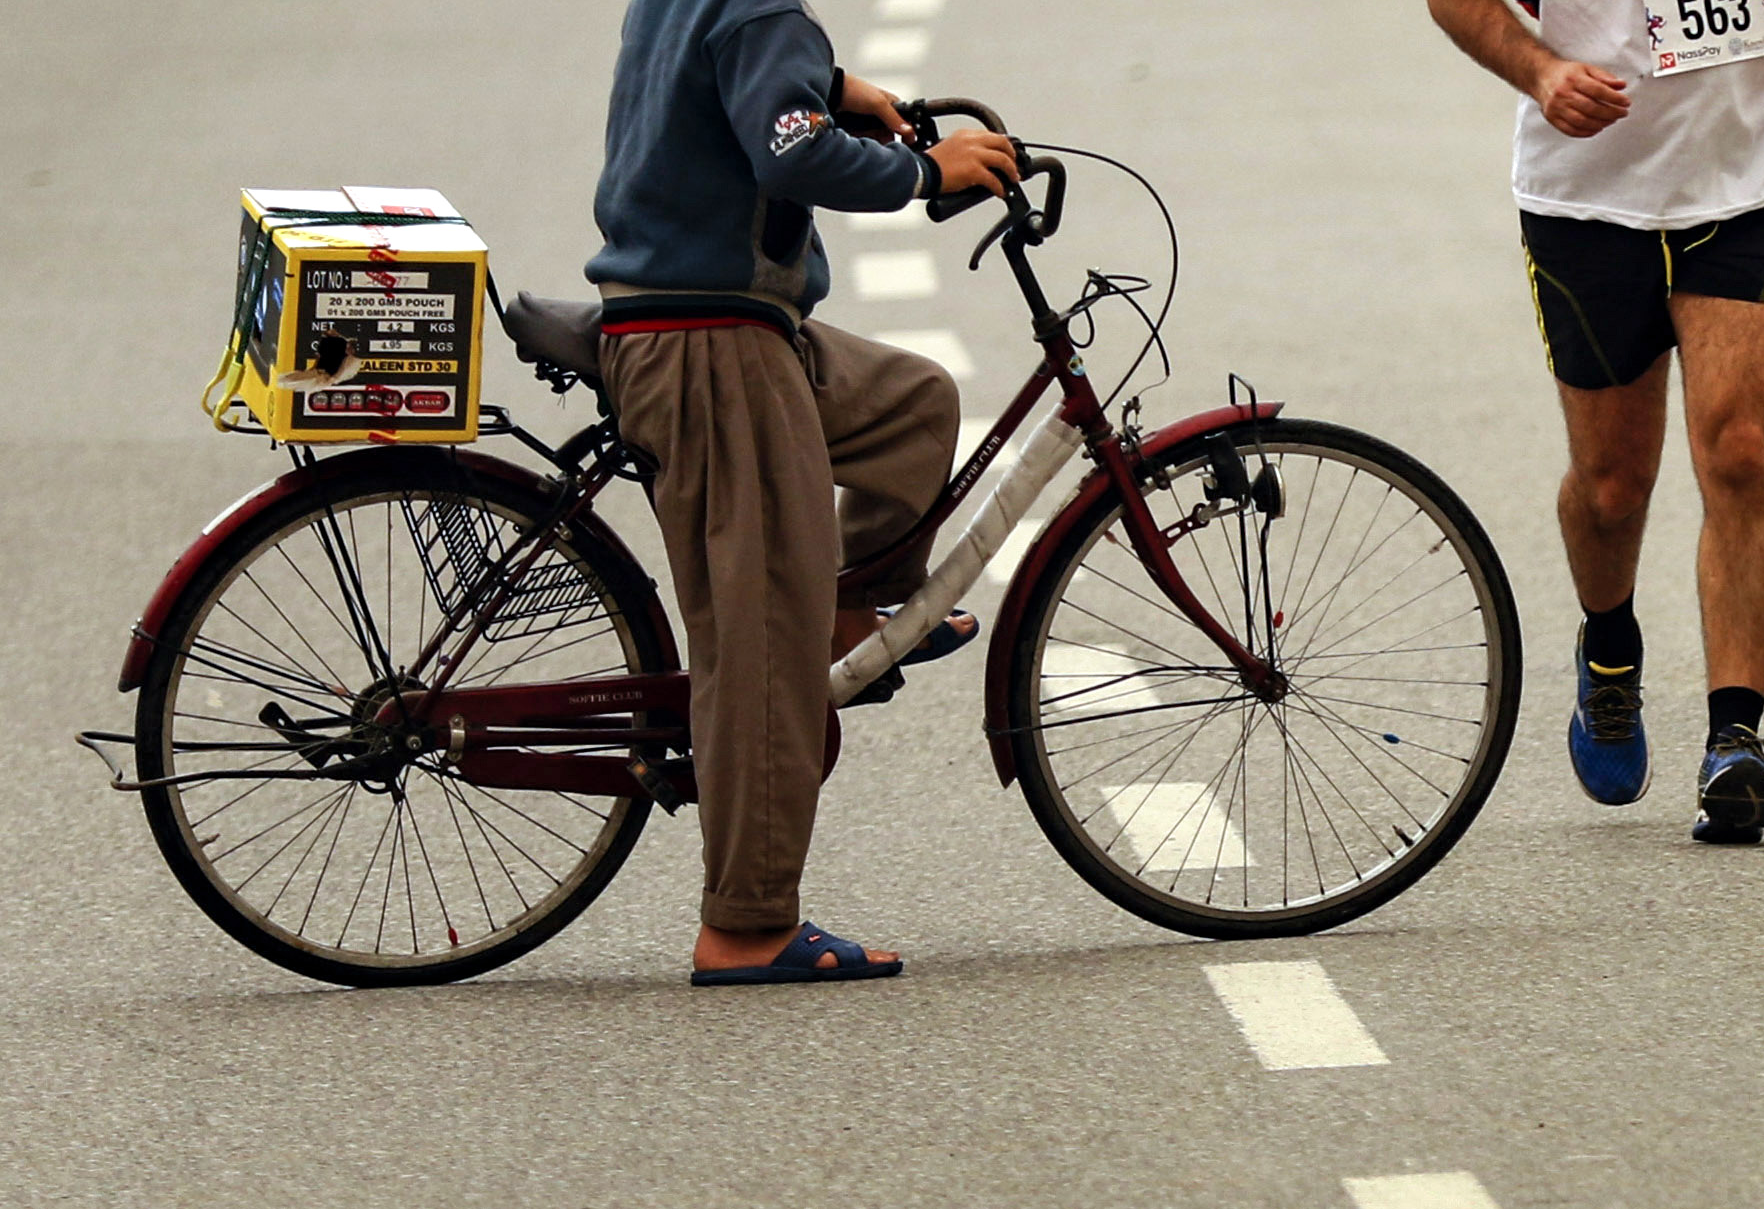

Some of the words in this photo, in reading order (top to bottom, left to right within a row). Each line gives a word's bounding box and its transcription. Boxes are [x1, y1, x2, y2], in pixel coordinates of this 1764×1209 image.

[307, 271, 326, 289] LOT
[329, 297, 343, 306] 20
[355, 298, 375, 306] 200
[378, 298, 403, 307] GMS
[405, 298, 445, 308] POUCH
[327, 308, 338, 316] 01
[366, 309, 386, 317] GMS
[388, 309, 420, 317] POUCH
[311, 321, 336, 332] NET
[429, 322, 456, 333] KGS
[428, 342, 454, 352] KGS
[360, 360, 405, 372] ALEEN
[407, 361, 433, 372] STD
[435, 361, 451, 372] 30
